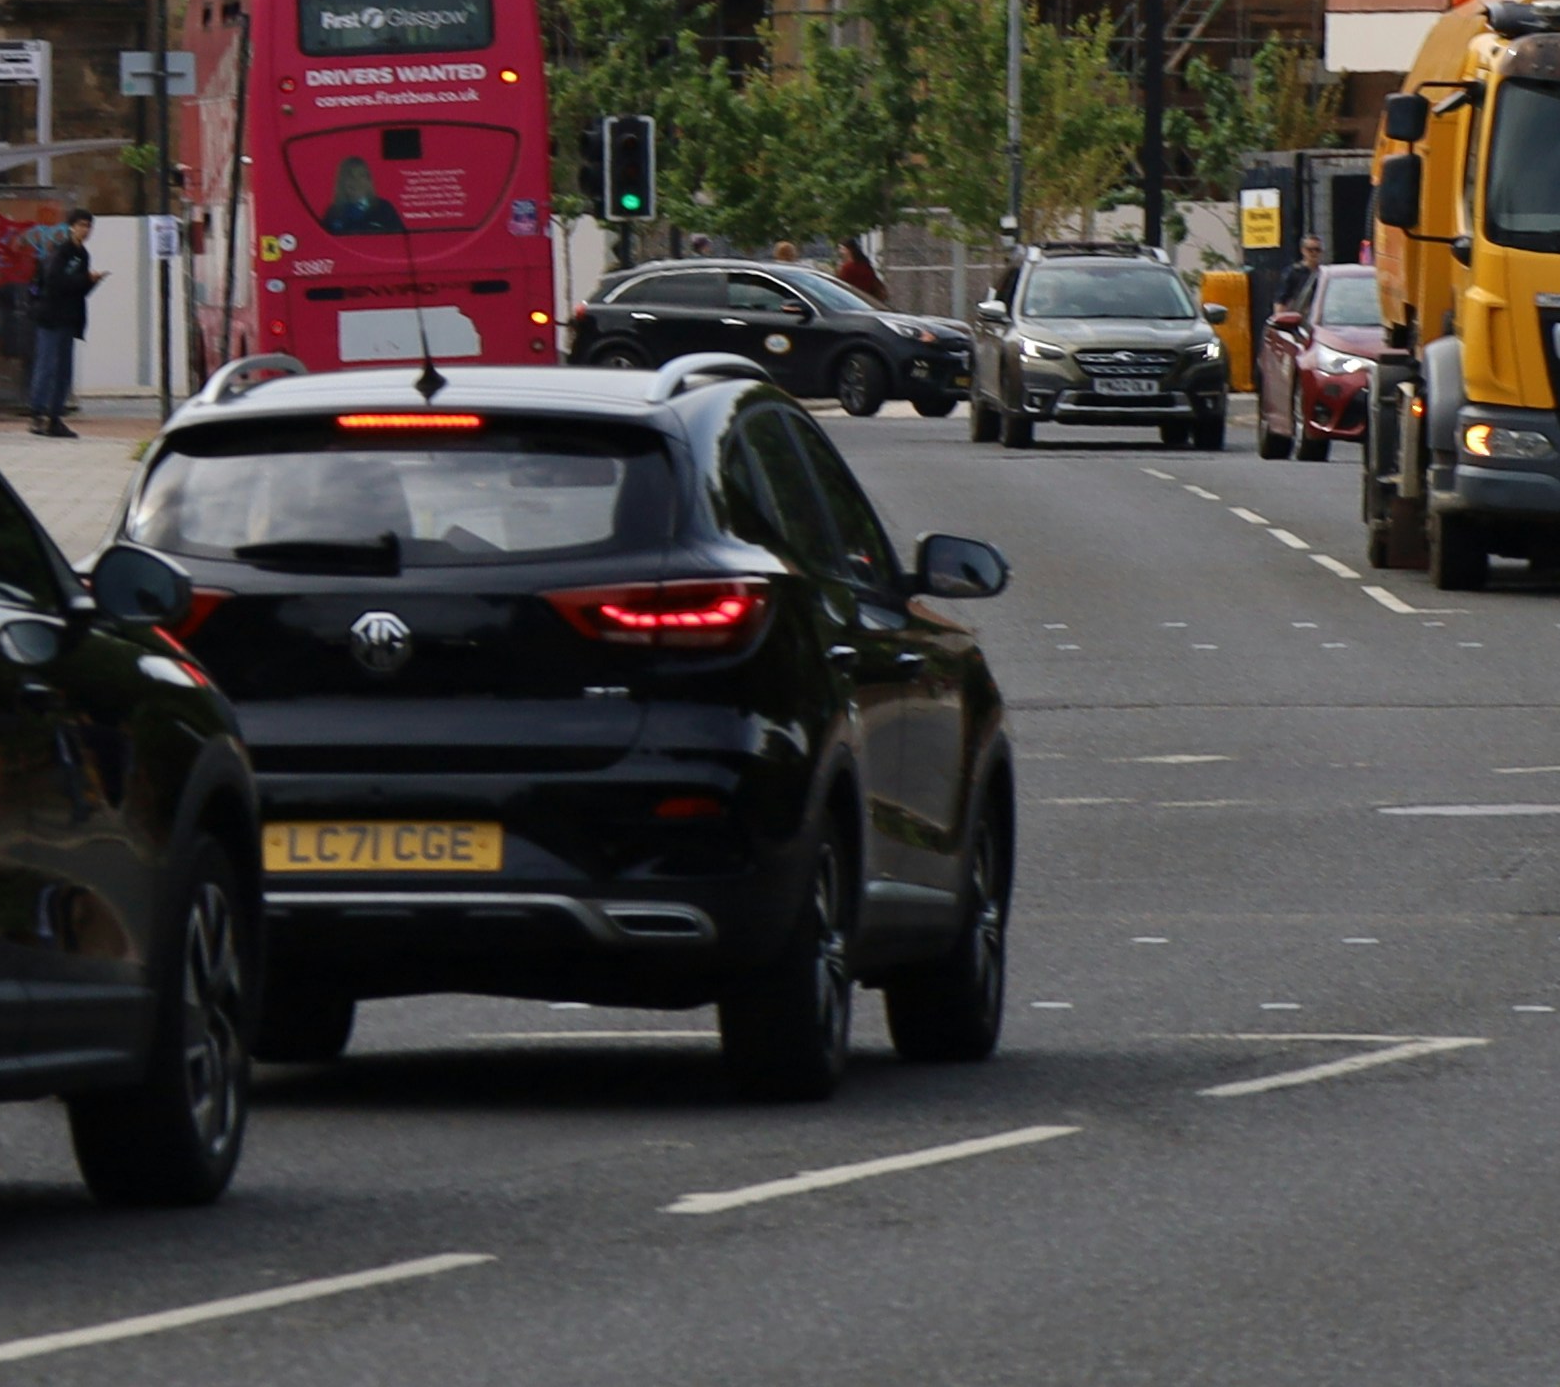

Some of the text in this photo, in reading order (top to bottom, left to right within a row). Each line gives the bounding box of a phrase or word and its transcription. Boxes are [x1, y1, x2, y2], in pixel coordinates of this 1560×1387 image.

[321, 8, 468, 29] First Glasgow
[305, 64, 487, 86] DRIVERS WANTED
[287, 827, 475, 864] LC71 CGE
